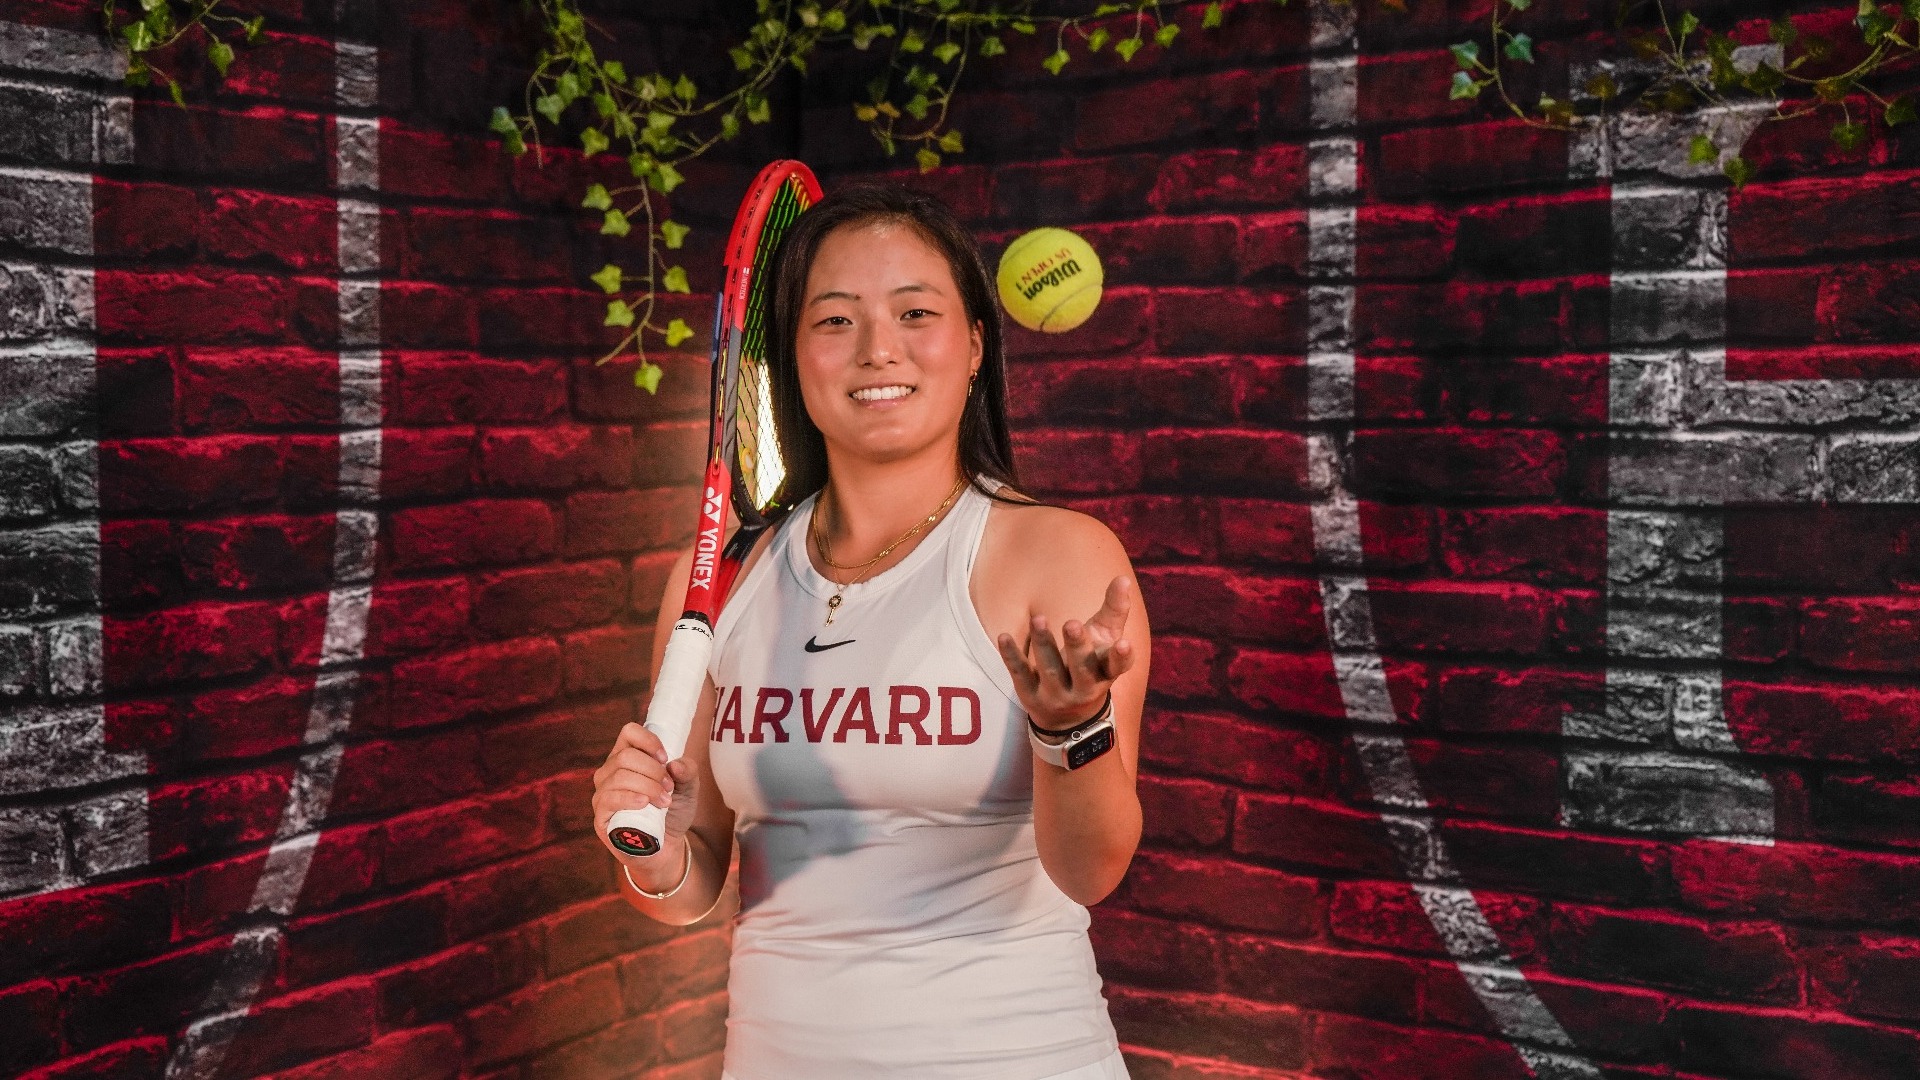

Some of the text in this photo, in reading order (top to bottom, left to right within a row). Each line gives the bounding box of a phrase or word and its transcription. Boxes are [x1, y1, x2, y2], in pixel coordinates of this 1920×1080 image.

[1022, 258, 1054, 284] OPEN
[1023, 259, 1082, 300] Wilson
[690, 527, 719, 590] YONEX
